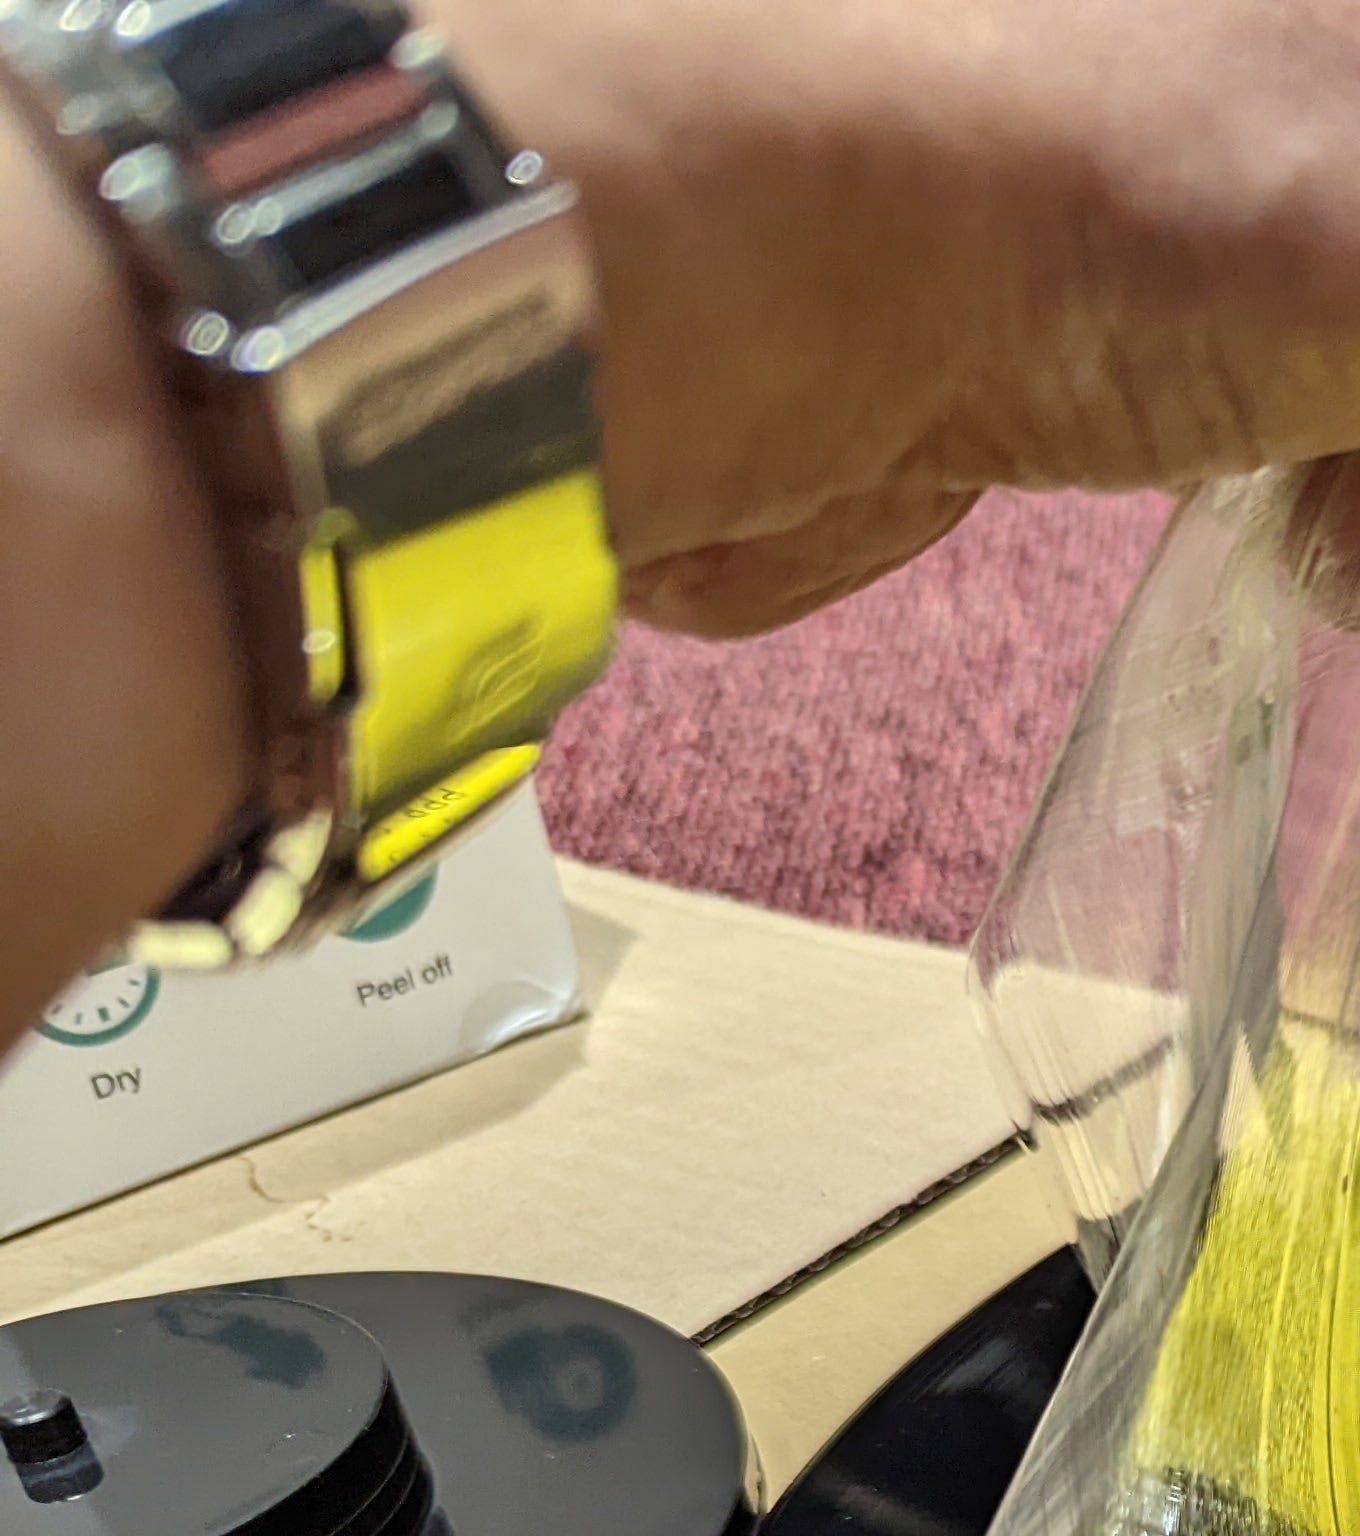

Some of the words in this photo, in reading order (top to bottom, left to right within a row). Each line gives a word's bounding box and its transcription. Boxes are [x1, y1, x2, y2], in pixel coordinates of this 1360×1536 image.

[355, 969, 417, 1007] Peel
[419, 953, 454, 986] off
[90, 1065, 144, 1100] Dry
